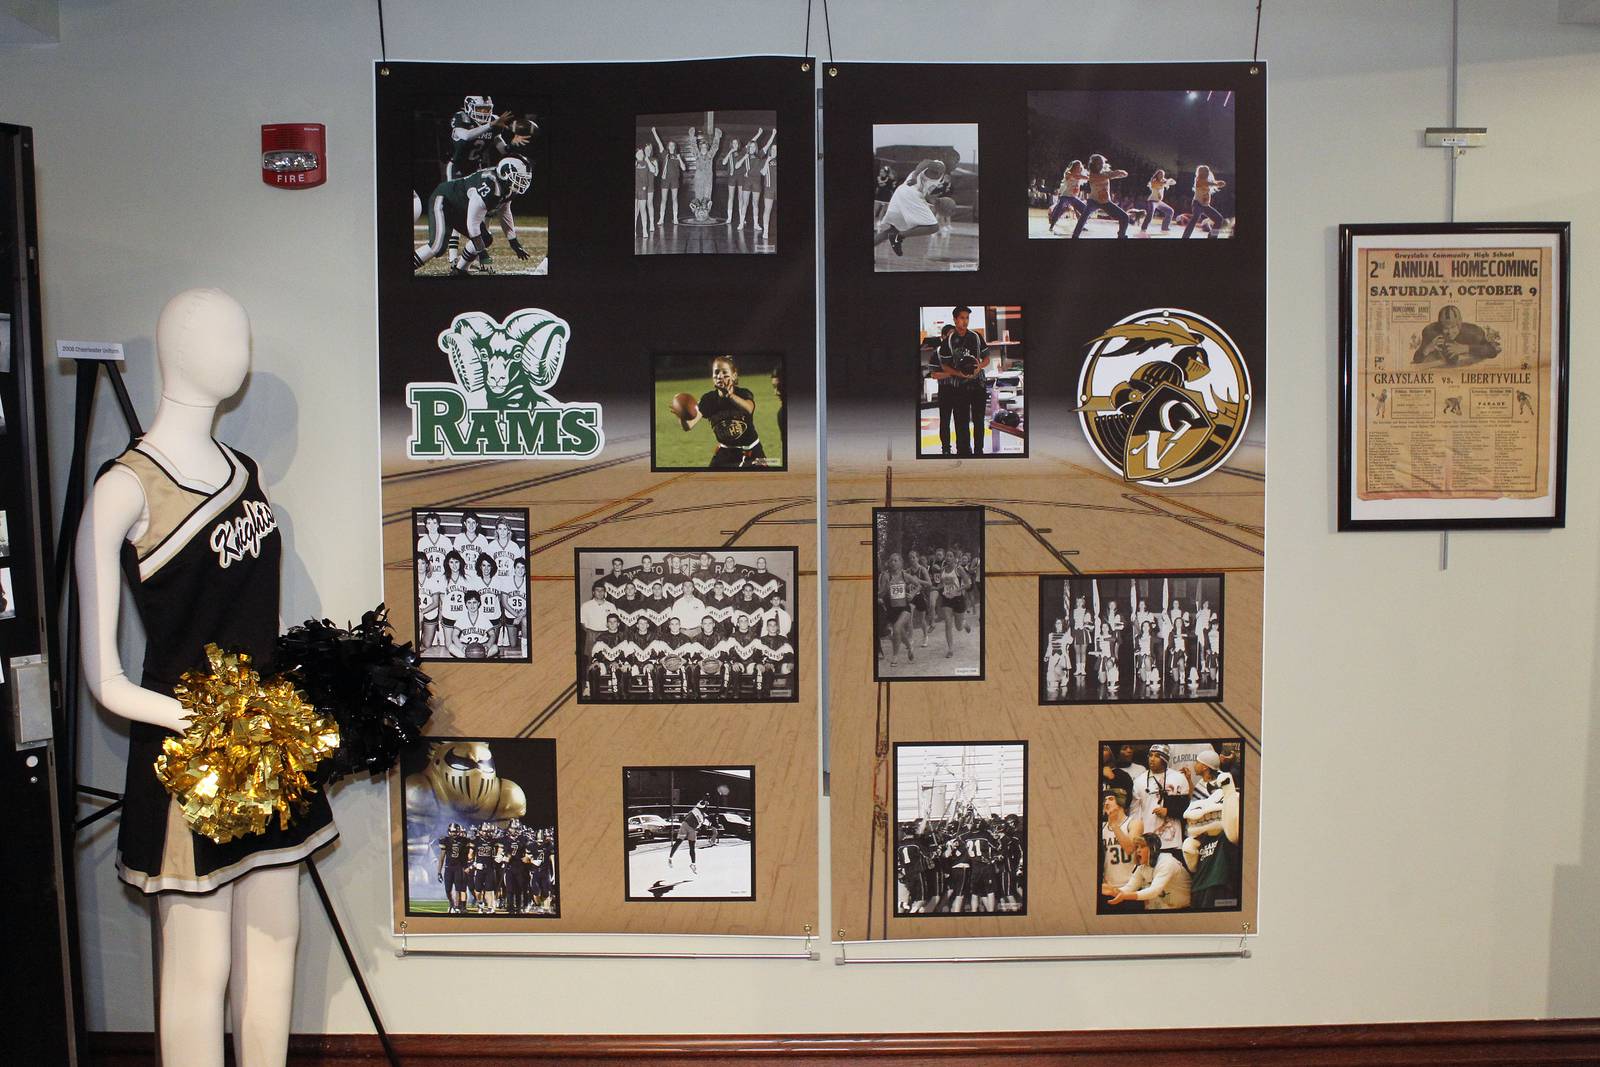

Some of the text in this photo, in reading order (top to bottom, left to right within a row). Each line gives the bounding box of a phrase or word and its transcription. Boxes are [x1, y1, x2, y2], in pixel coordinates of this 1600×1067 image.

[277, 174, 305, 183] FIRE
[1432, 251, 1470, 259] Community
[1393, 260, 1444, 278] ANNUAL
[1451, 259, 1538, 278] HOMECOMING
[1370, 285, 1538, 298] SATURDAY, OCTOBER 9
[1374, 373, 1434, 385] GRAYSLAKE
[1461, 372, 1532, 384] LIBERTYVILLE
[410, 388, 600, 455] RAMS
[512, 599, 522, 607] 35
